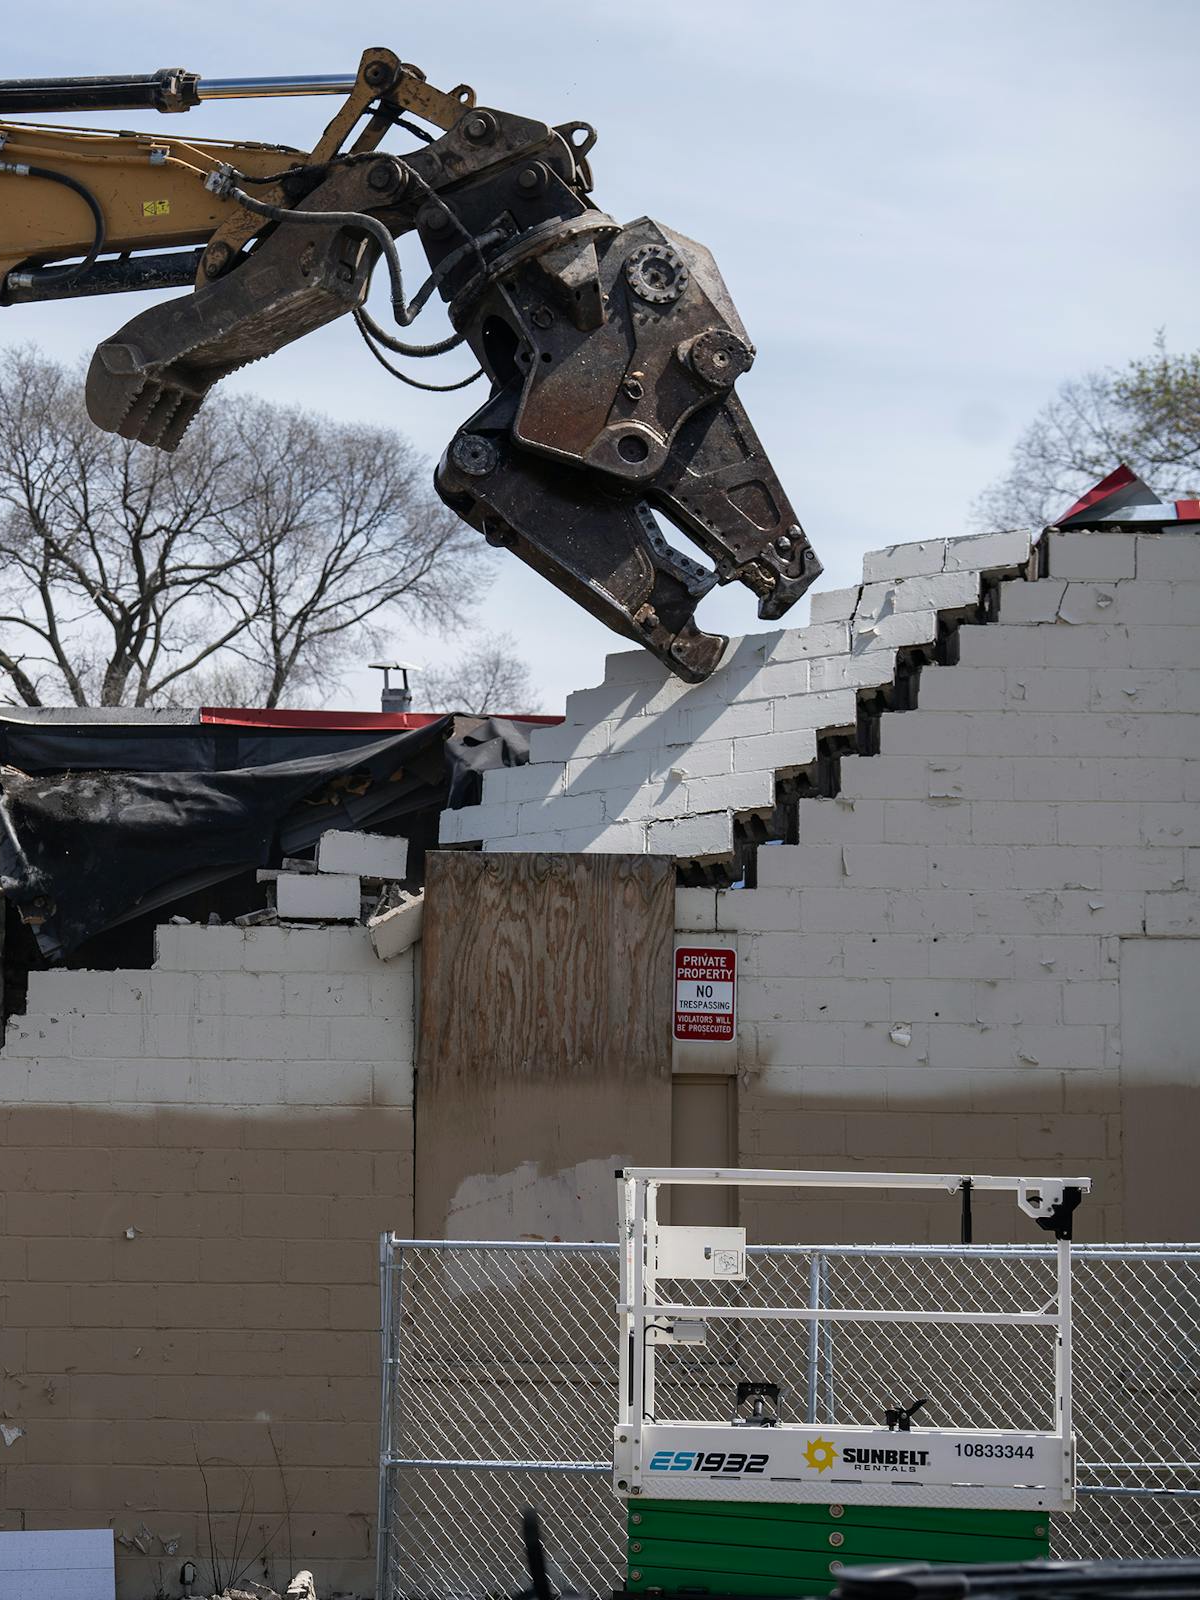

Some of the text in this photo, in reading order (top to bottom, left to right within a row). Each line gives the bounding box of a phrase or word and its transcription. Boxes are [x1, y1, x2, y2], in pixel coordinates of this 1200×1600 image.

[683, 956, 727, 967] PRIVATE
[677, 968, 733, 980] PROPERTY
[696, 985, 713, 998] NO
[680, 1000, 730, 1010] TRESPASSING
[677, 1015, 731, 1024] VIOLATORS WILL
[677, 1024, 732, 1033] BE PROSECUTED
[842, 1447, 929, 1466] SUNBELT
[954, 1443, 1035, 1459] 10833344
[649, 1451, 769, 1473] ES1932
[854, 1464, 917, 1473] RENTALS
